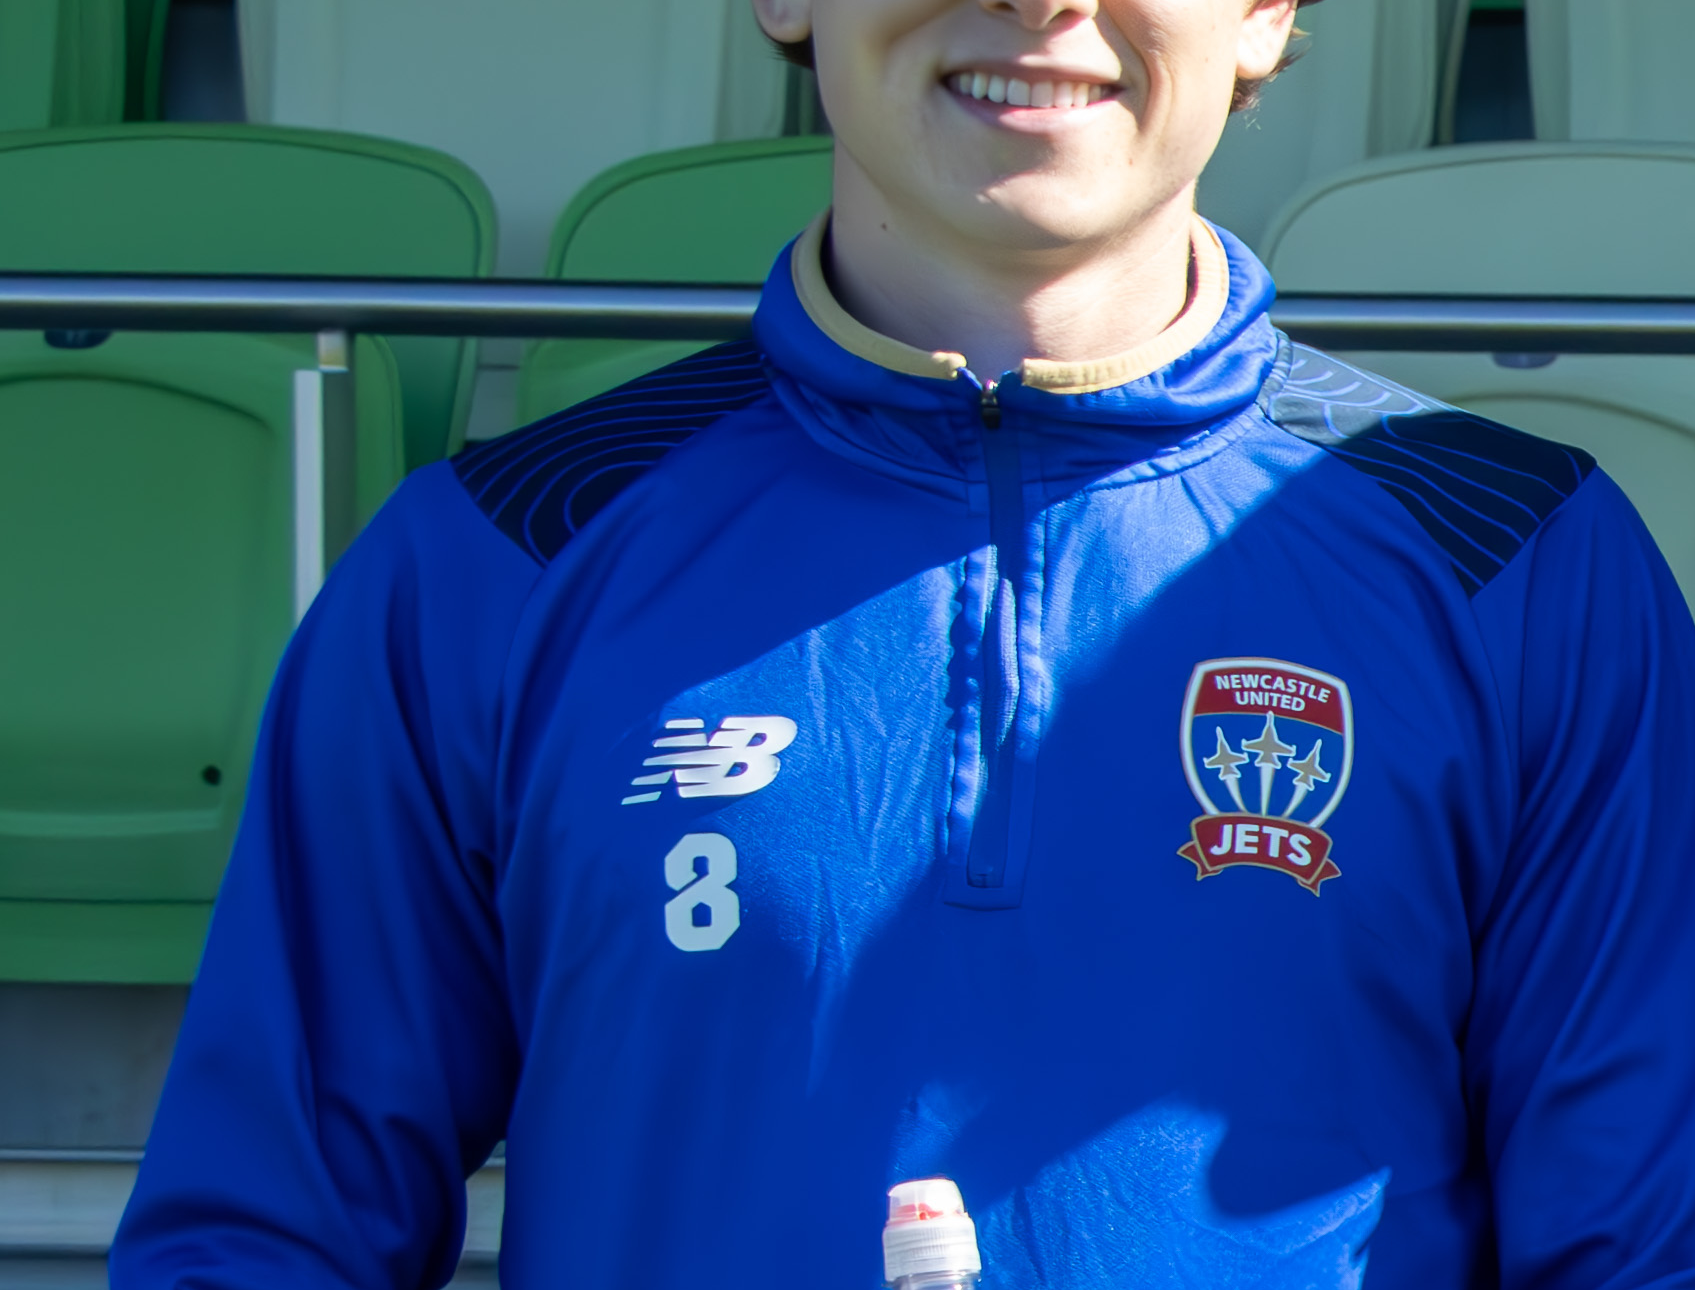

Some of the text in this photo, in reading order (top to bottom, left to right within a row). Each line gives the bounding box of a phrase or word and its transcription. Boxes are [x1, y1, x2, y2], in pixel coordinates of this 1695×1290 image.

[1215, 674, 1332, 704] NEWCASTLE
[1234, 691, 1306, 712] UNITED
[1209, 823, 1312, 866] JETS
[664, 833, 741, 952] 8
